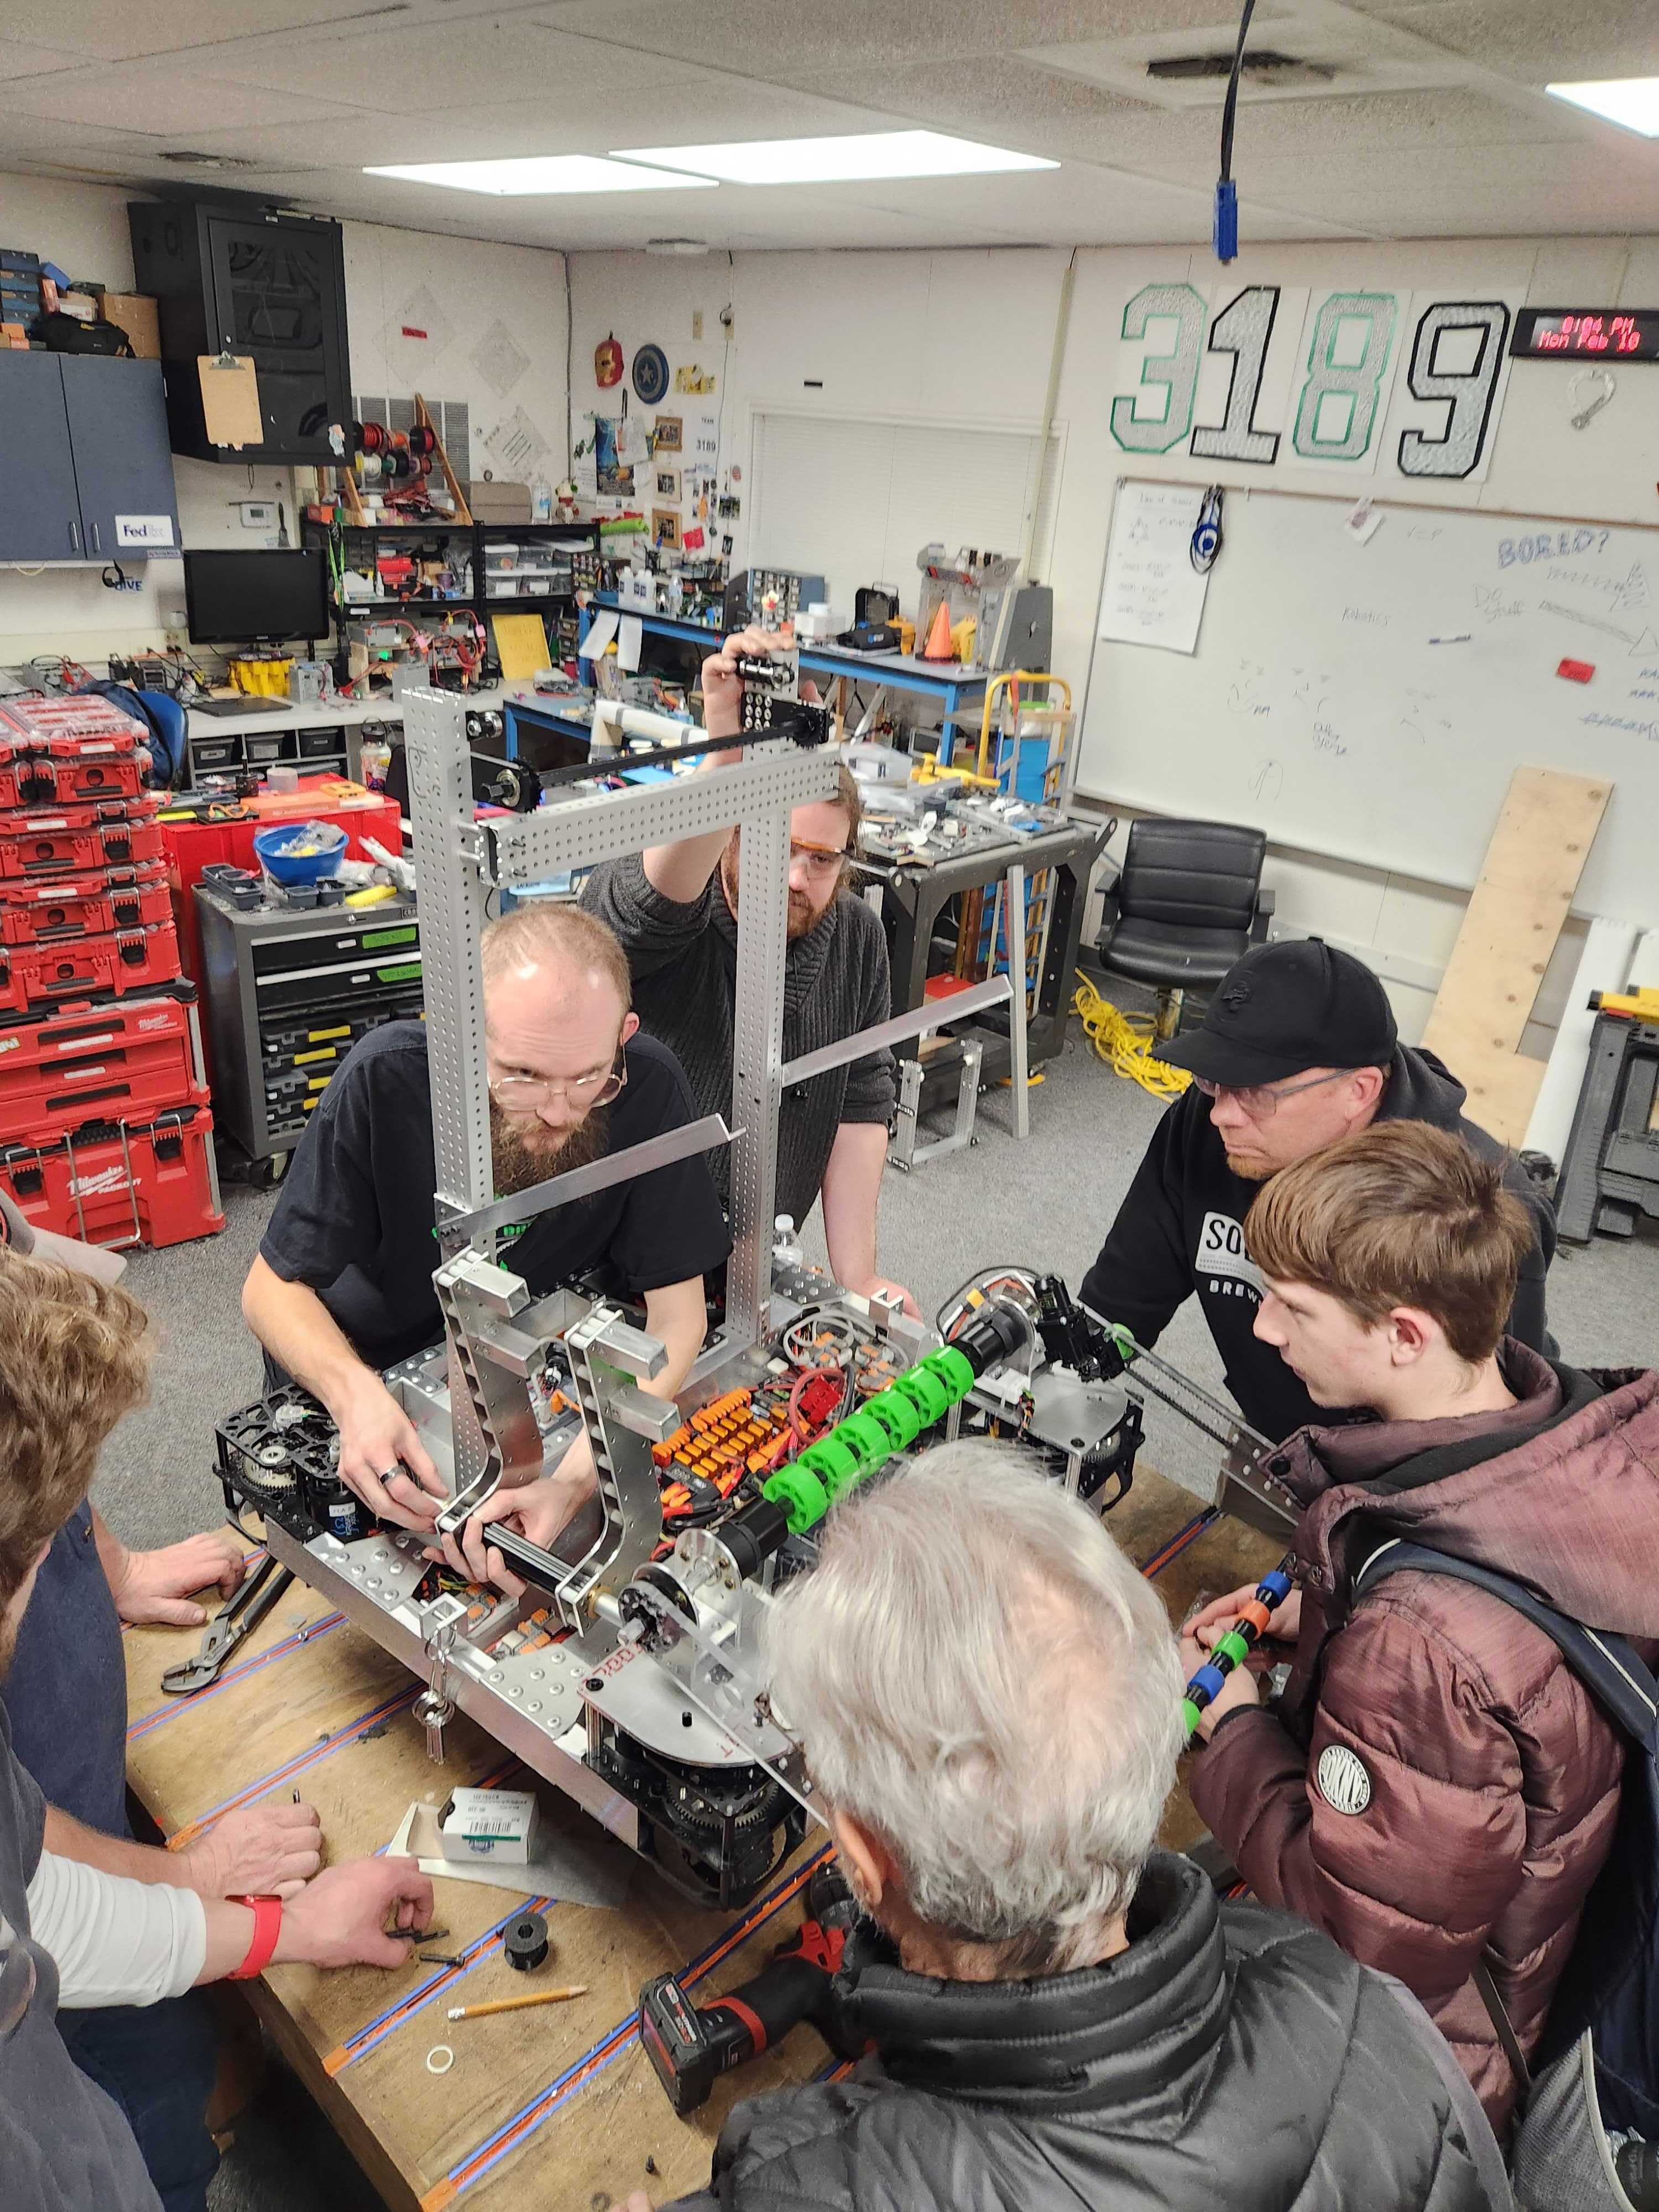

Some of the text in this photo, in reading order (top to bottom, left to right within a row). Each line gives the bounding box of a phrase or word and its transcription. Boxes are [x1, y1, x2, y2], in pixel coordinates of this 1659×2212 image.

[1610, 316, 1635, 336] PM
[1538, 330, 1569, 349] Mon
[1616, 331, 1641, 351] 10
[1109, 283, 1511, 479] 3189
[696, 438, 716, 452] 3189
[1206, 1219, 1256, 1264] SO
